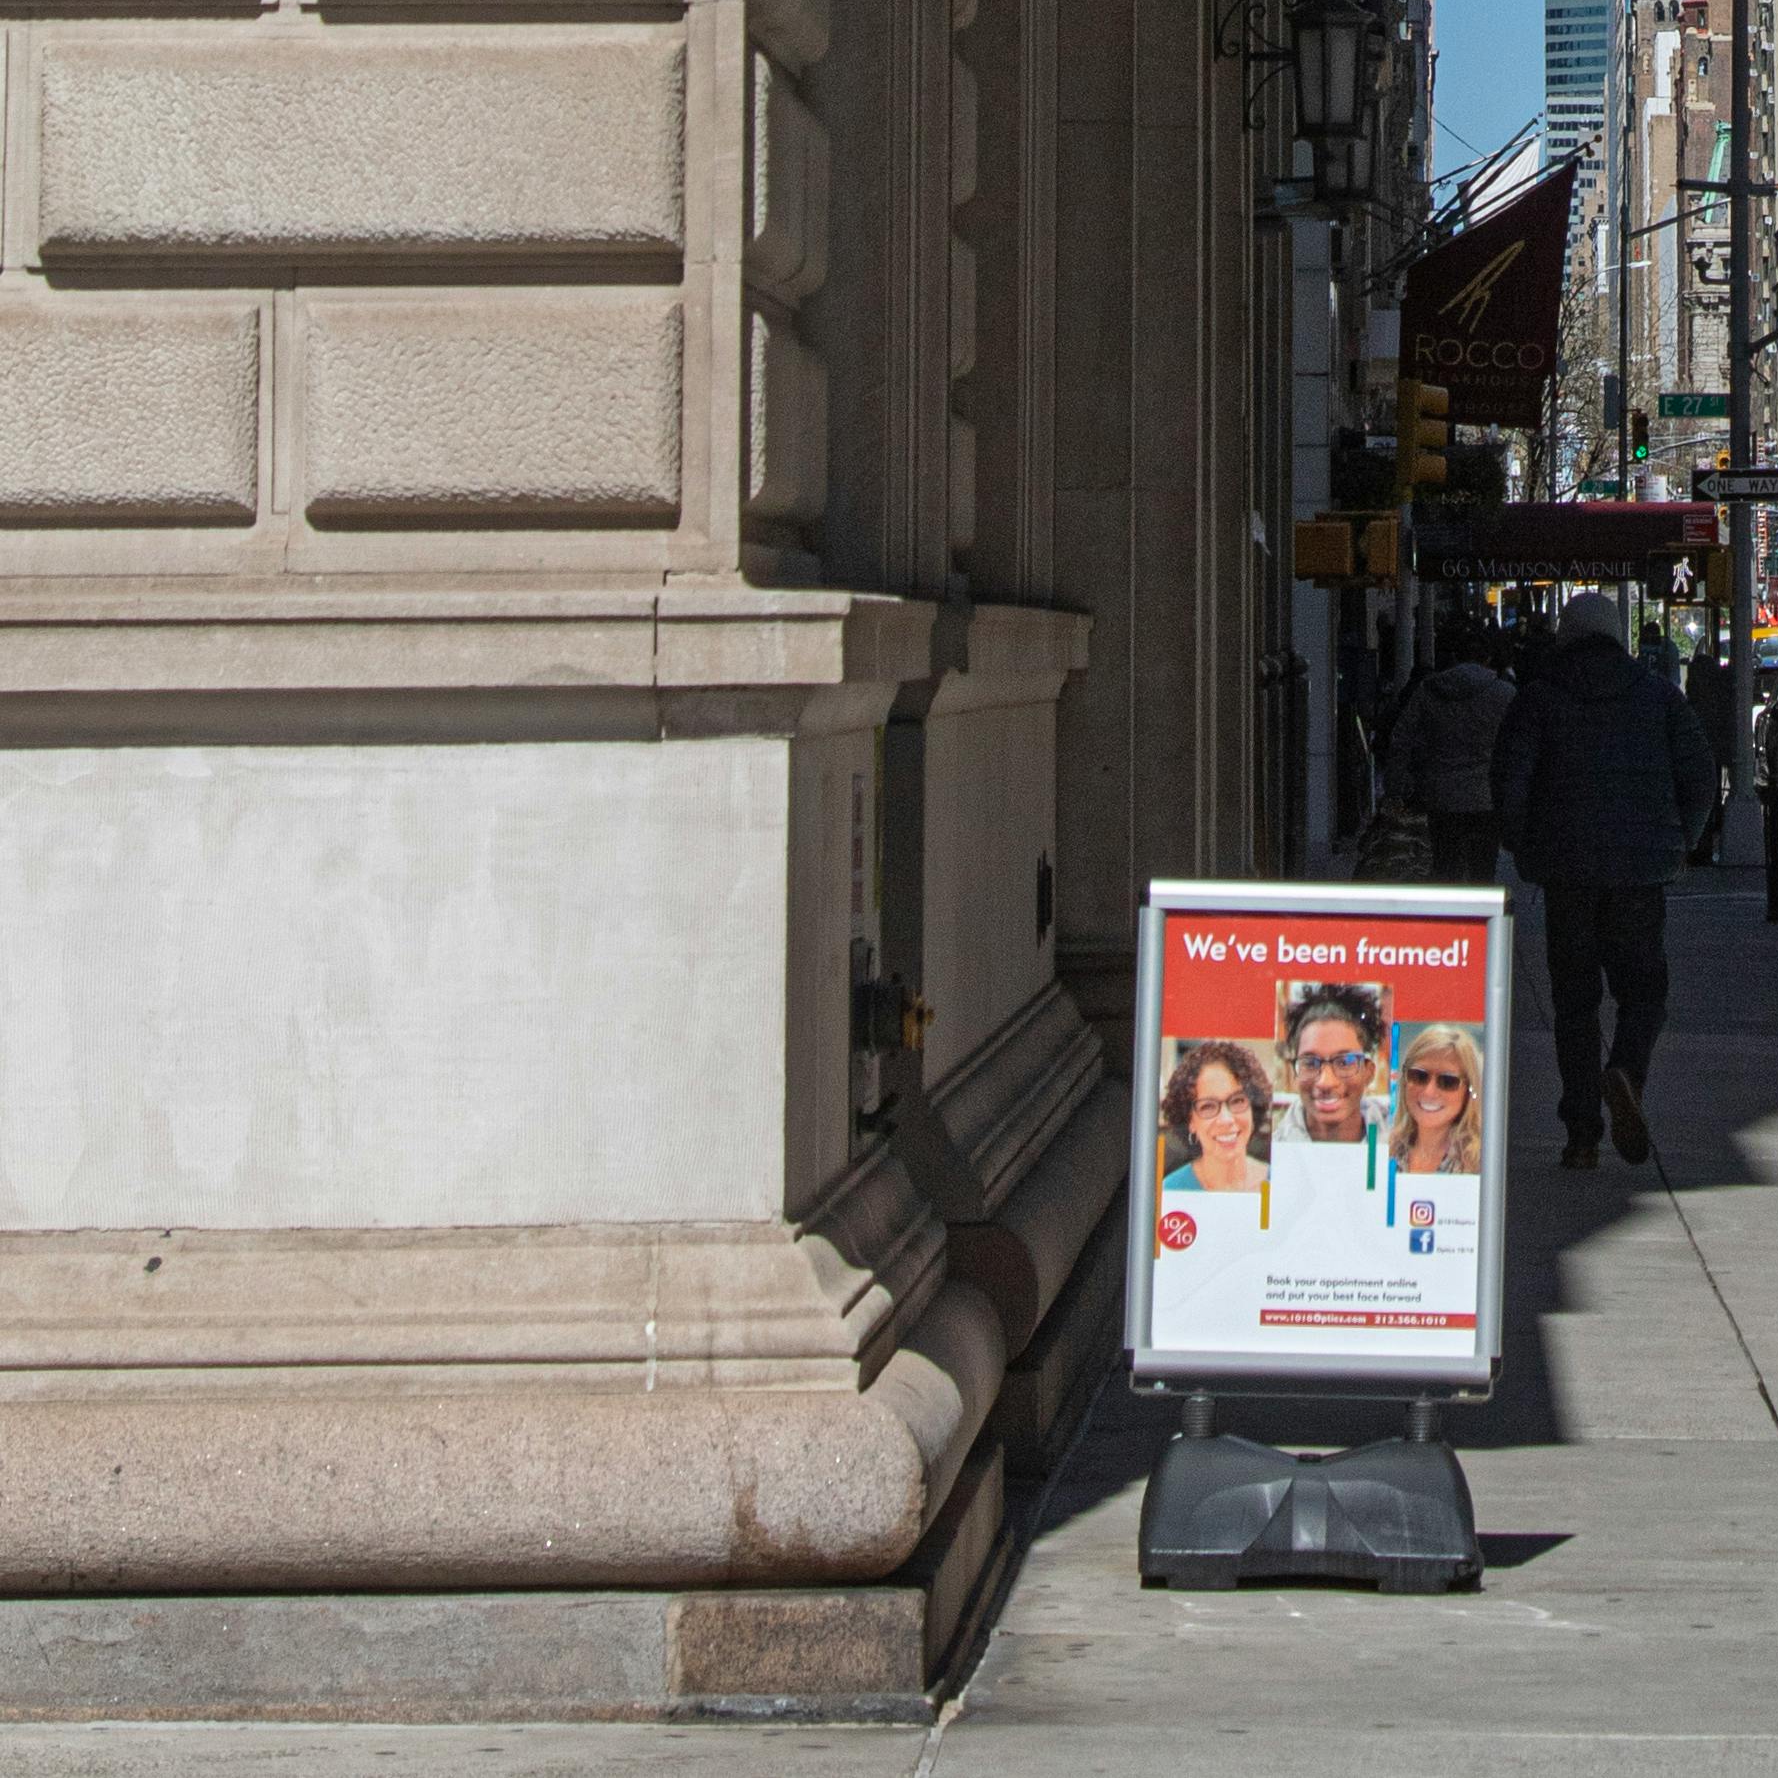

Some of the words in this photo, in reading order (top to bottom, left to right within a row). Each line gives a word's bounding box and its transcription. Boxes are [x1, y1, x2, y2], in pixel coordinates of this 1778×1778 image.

[1414, 333, 1545, 370] ROCCO
[1664, 397, 1674, 415] E
[1682, 396, 1703, 415] 27
[1710, 397, 1719, 406] ST
[1707, 479, 1734, 493] ONE
[1748, 479, 1778, 492] WAY
[1442, 560, 1469, 577] 66
[1478, 559, 1562, 577] MADISON
[1567, 559, 1636, 577] AVENUE
[1183, 933, 1267, 962] We've
[1277, 934, 1346, 964] been
[1356, 936, 1470, 967] framed!
[1266, 1275, 1291, 1286] Book
[1294, 1278, 1316, 1287] your
[1319, 1278, 1384, 1288] appointment
[1387, 1278, 1418, 1287] online
[1266, 1290, 1285, 1300] and
[1288, 1292, 1305, 1302] put
[1307, 1294, 1330, 1302] your
[1332, 1292, 1354, 1301] best
[1357, 1292, 1379, 1302] face
[1382, 1293, 1422, 1303] forward
